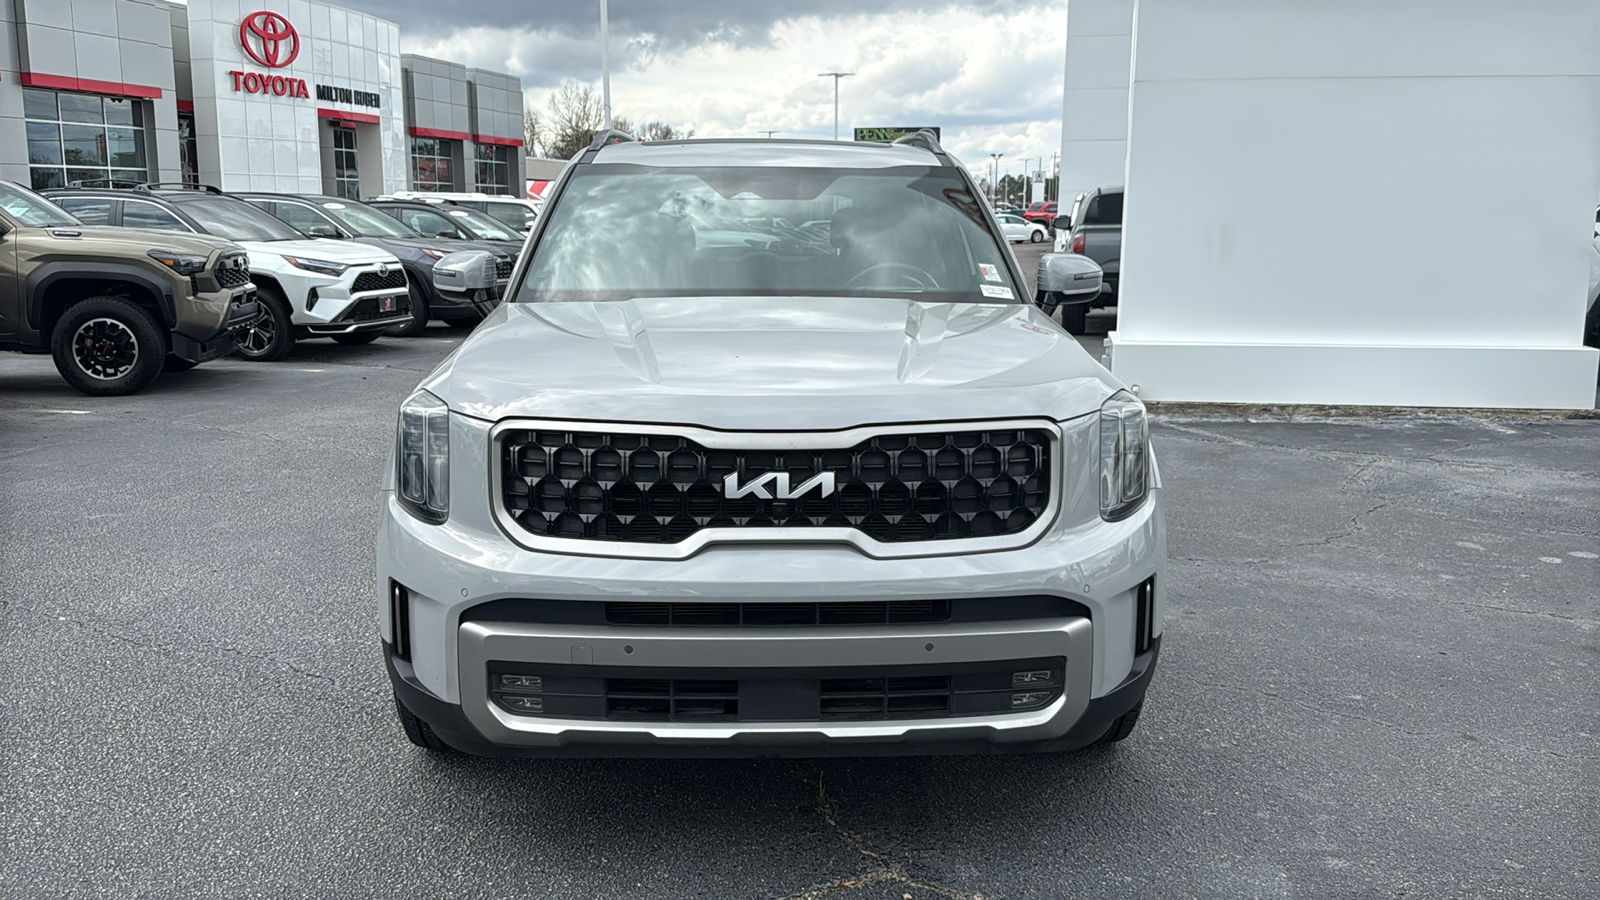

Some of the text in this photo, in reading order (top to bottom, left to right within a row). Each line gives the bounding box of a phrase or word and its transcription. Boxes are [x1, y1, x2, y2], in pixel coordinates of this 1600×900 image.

[230, 70, 310, 99] TOYOTA
[316, 84, 353, 104] MILTON
[723, 471, 836, 499] KIA
